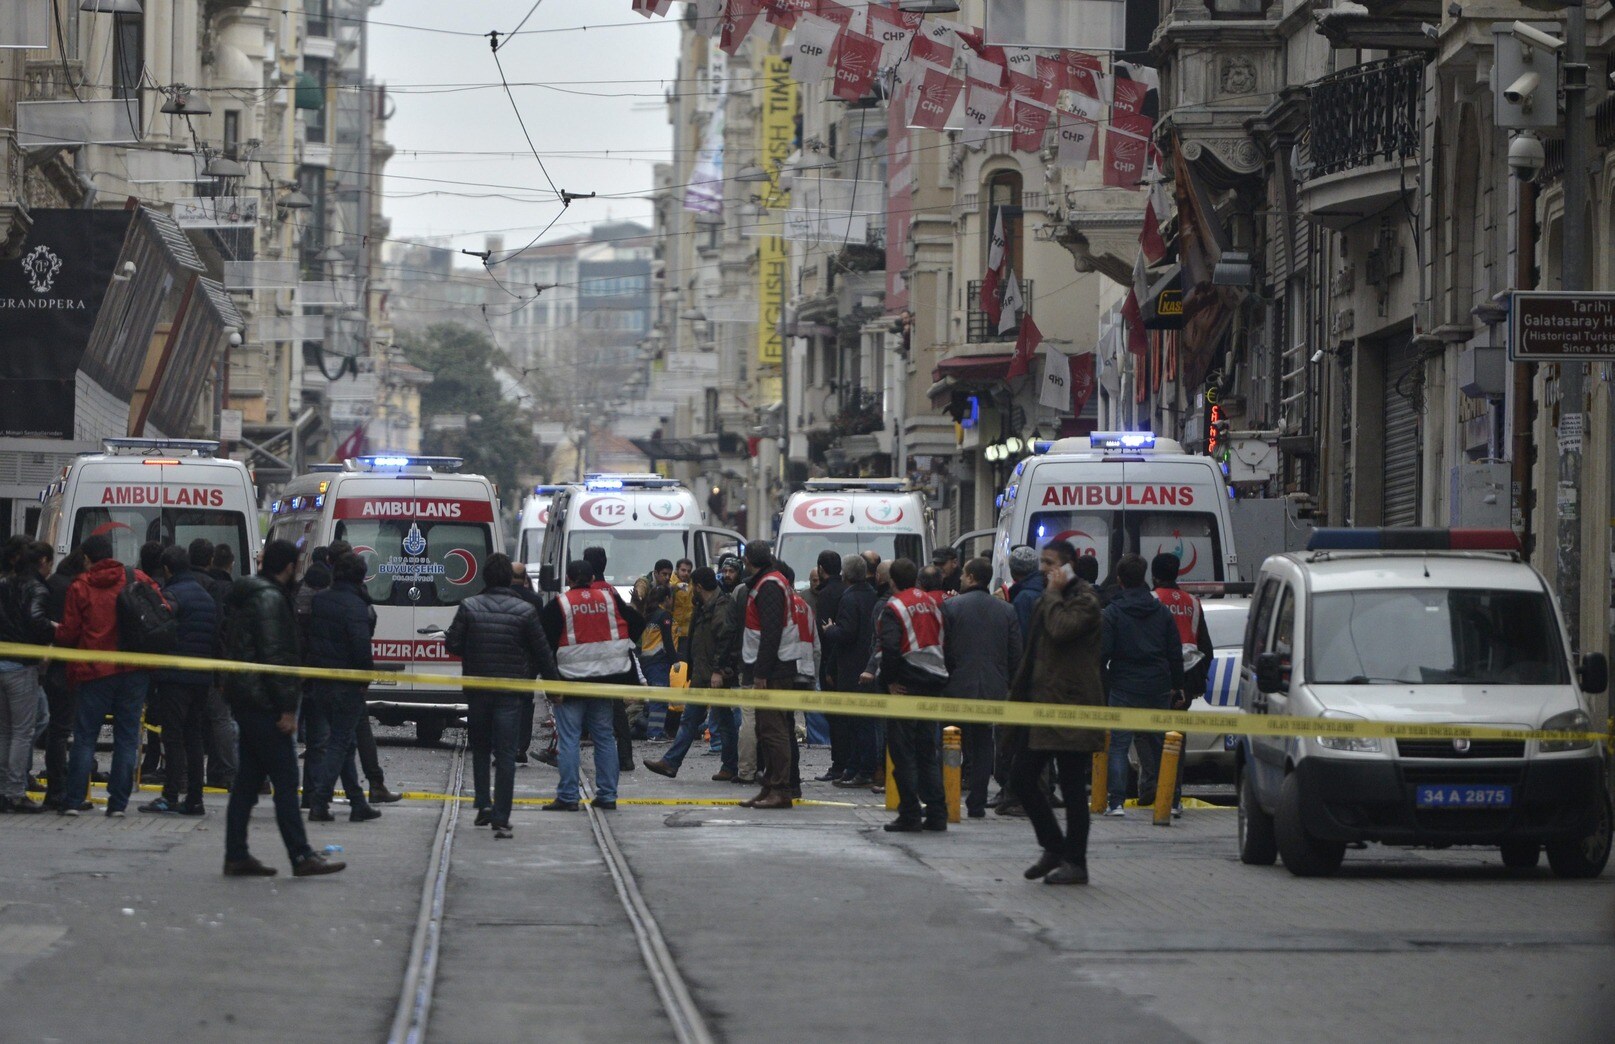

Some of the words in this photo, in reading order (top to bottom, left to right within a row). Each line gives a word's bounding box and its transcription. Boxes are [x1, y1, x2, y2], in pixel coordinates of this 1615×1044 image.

[883, 31, 905, 41] CHP
[800, 44, 823, 57] CHP
[837, 69, 860, 84] CHP
[1066, 65, 1087, 79] CHP
[921, 100, 945, 115] CHP
[966, 106, 987, 121] CHP
[1013, 123, 1036, 136] CHP
[1062, 130, 1085, 143] CHP
[1113, 160, 1136, 173] CHP
[1001, 296, 1014, 308] HP
[1162, 301, 1183, 312] KAS
[1571, 300, 1611, 313] Tarihi
[1524, 313, 1600, 330] Galatasaray
[1562, 343, 1592, 353] Since
[101, 486, 224, 507] AMBULANS
[1042, 485, 1194, 506] AMBULANS
[362, 501, 461, 518] AMBULANS
[594, 504, 626, 515] 112
[808, 506, 845, 517] 112
[572, 601, 607, 615] POLİS
[371, 642, 412, 658] HIZIR
[414, 642, 450, 658] ACİL
[1424, 790, 1444, 802] 34
[1449, 790, 1461, 802] A
[1465, 790, 1505, 802] 2875
